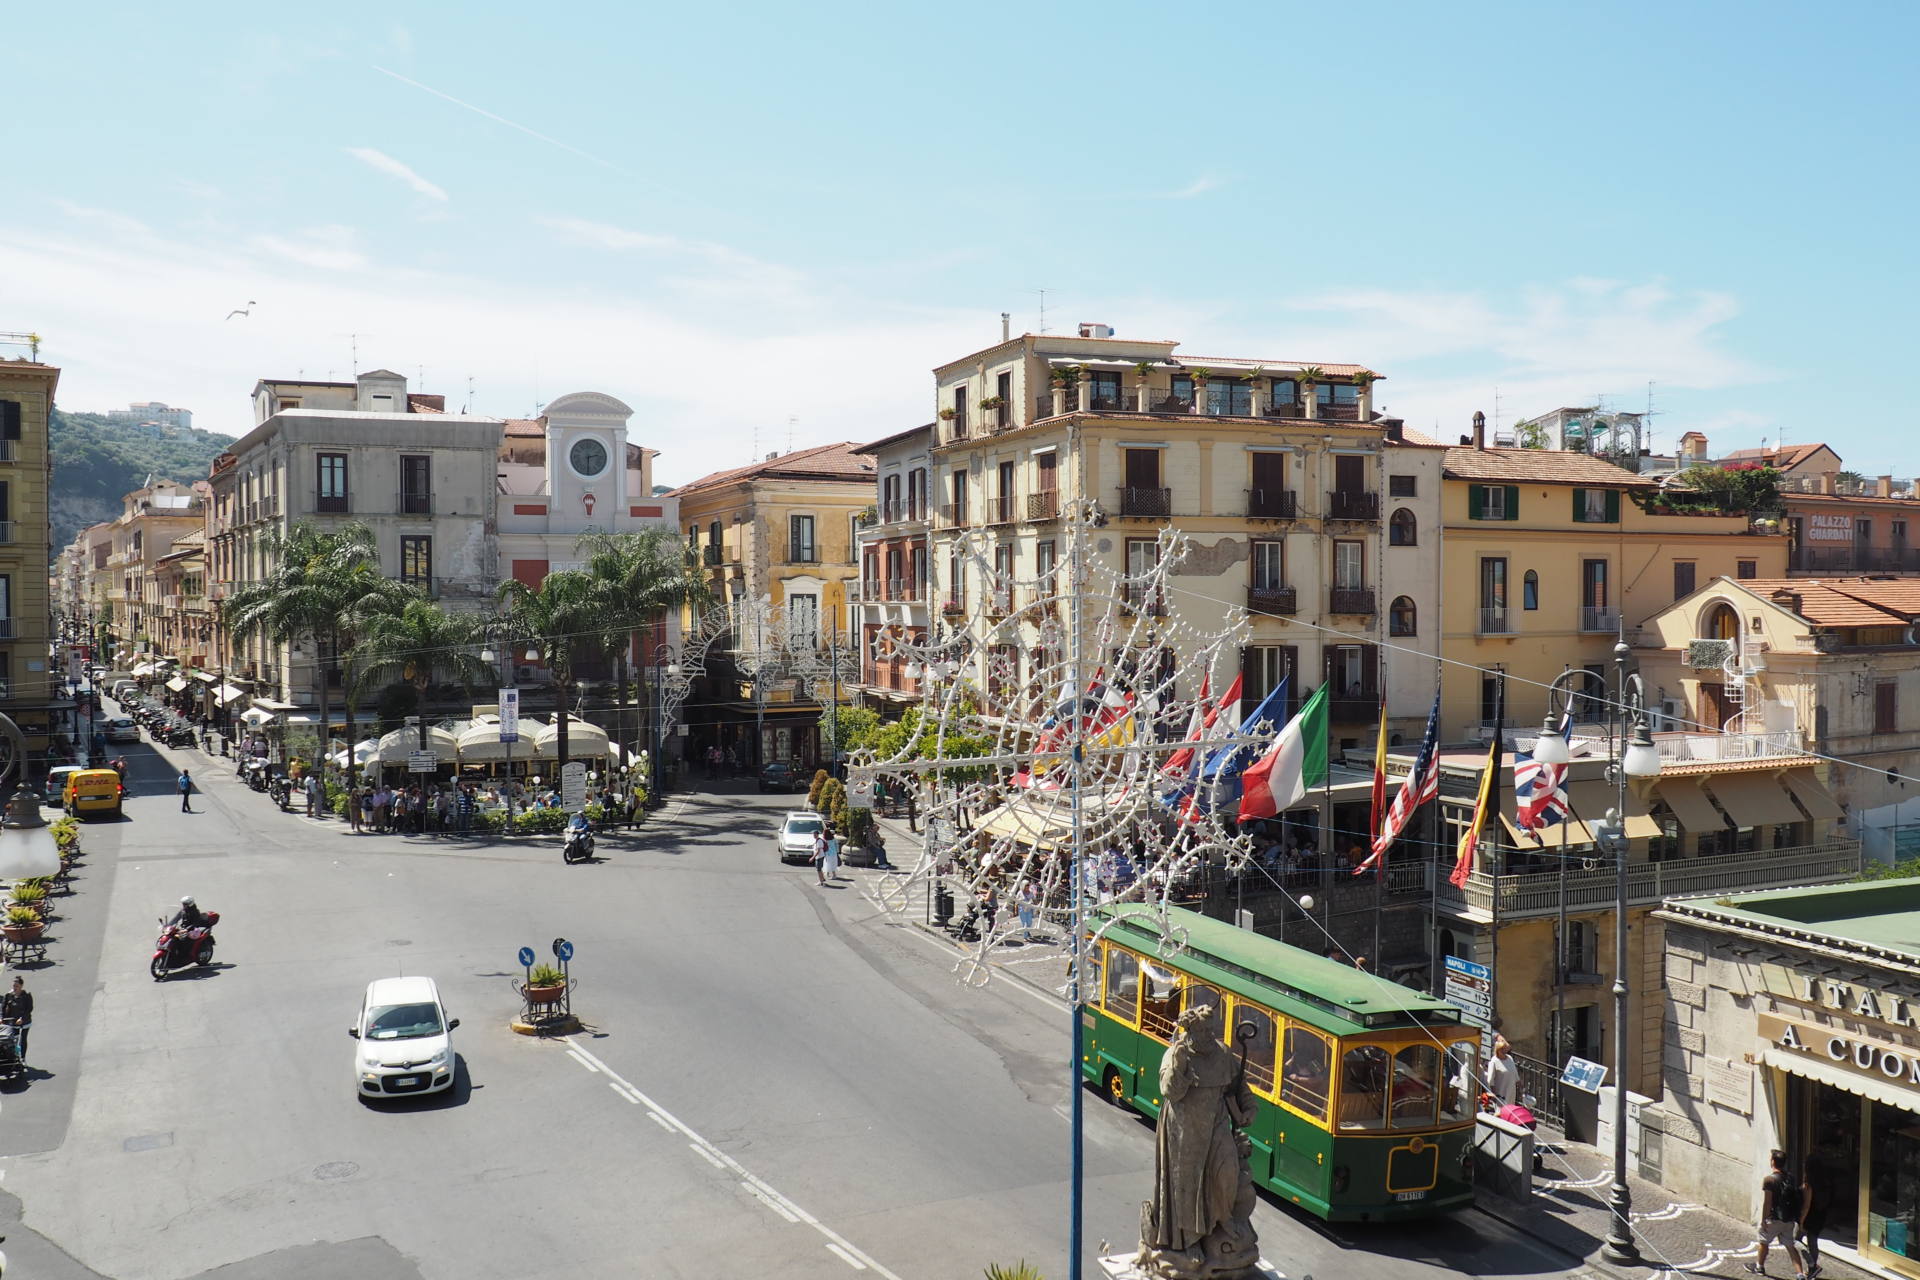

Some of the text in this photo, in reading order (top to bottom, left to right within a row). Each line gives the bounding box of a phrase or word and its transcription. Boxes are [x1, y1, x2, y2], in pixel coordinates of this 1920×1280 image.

[1811, 515, 1850, 528] PALAZZO
[1809, 528, 1853, 541] GUARDATI
[1447, 958, 1466, 970] NAPOLI
[1780, 1024, 1808, 1052] A.
